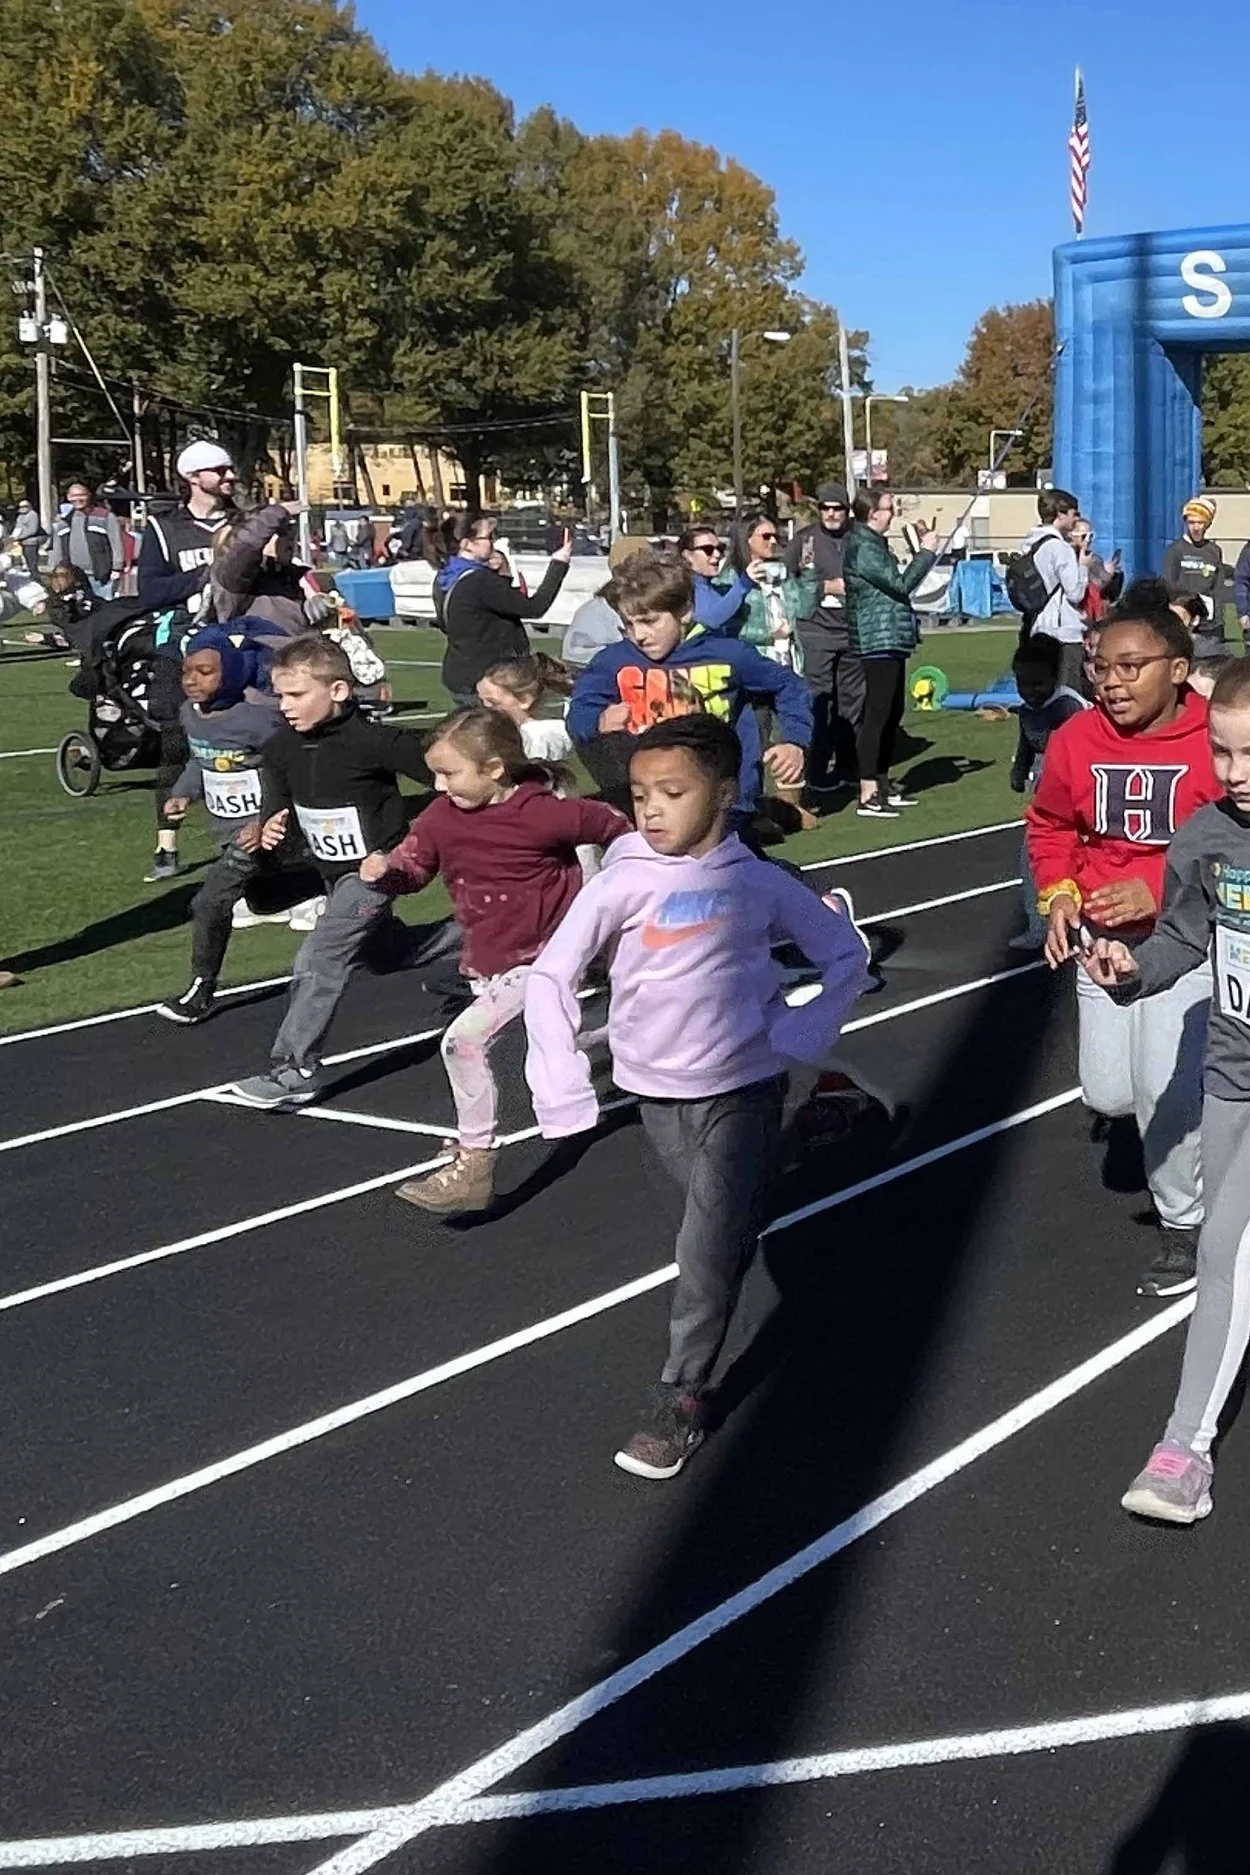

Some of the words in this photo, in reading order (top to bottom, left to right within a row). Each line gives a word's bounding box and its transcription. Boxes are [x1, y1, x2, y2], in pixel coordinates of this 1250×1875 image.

[206, 792, 259, 815] DASH
[1090, 764, 1189, 845] H
[311, 833, 359, 857] ASH
